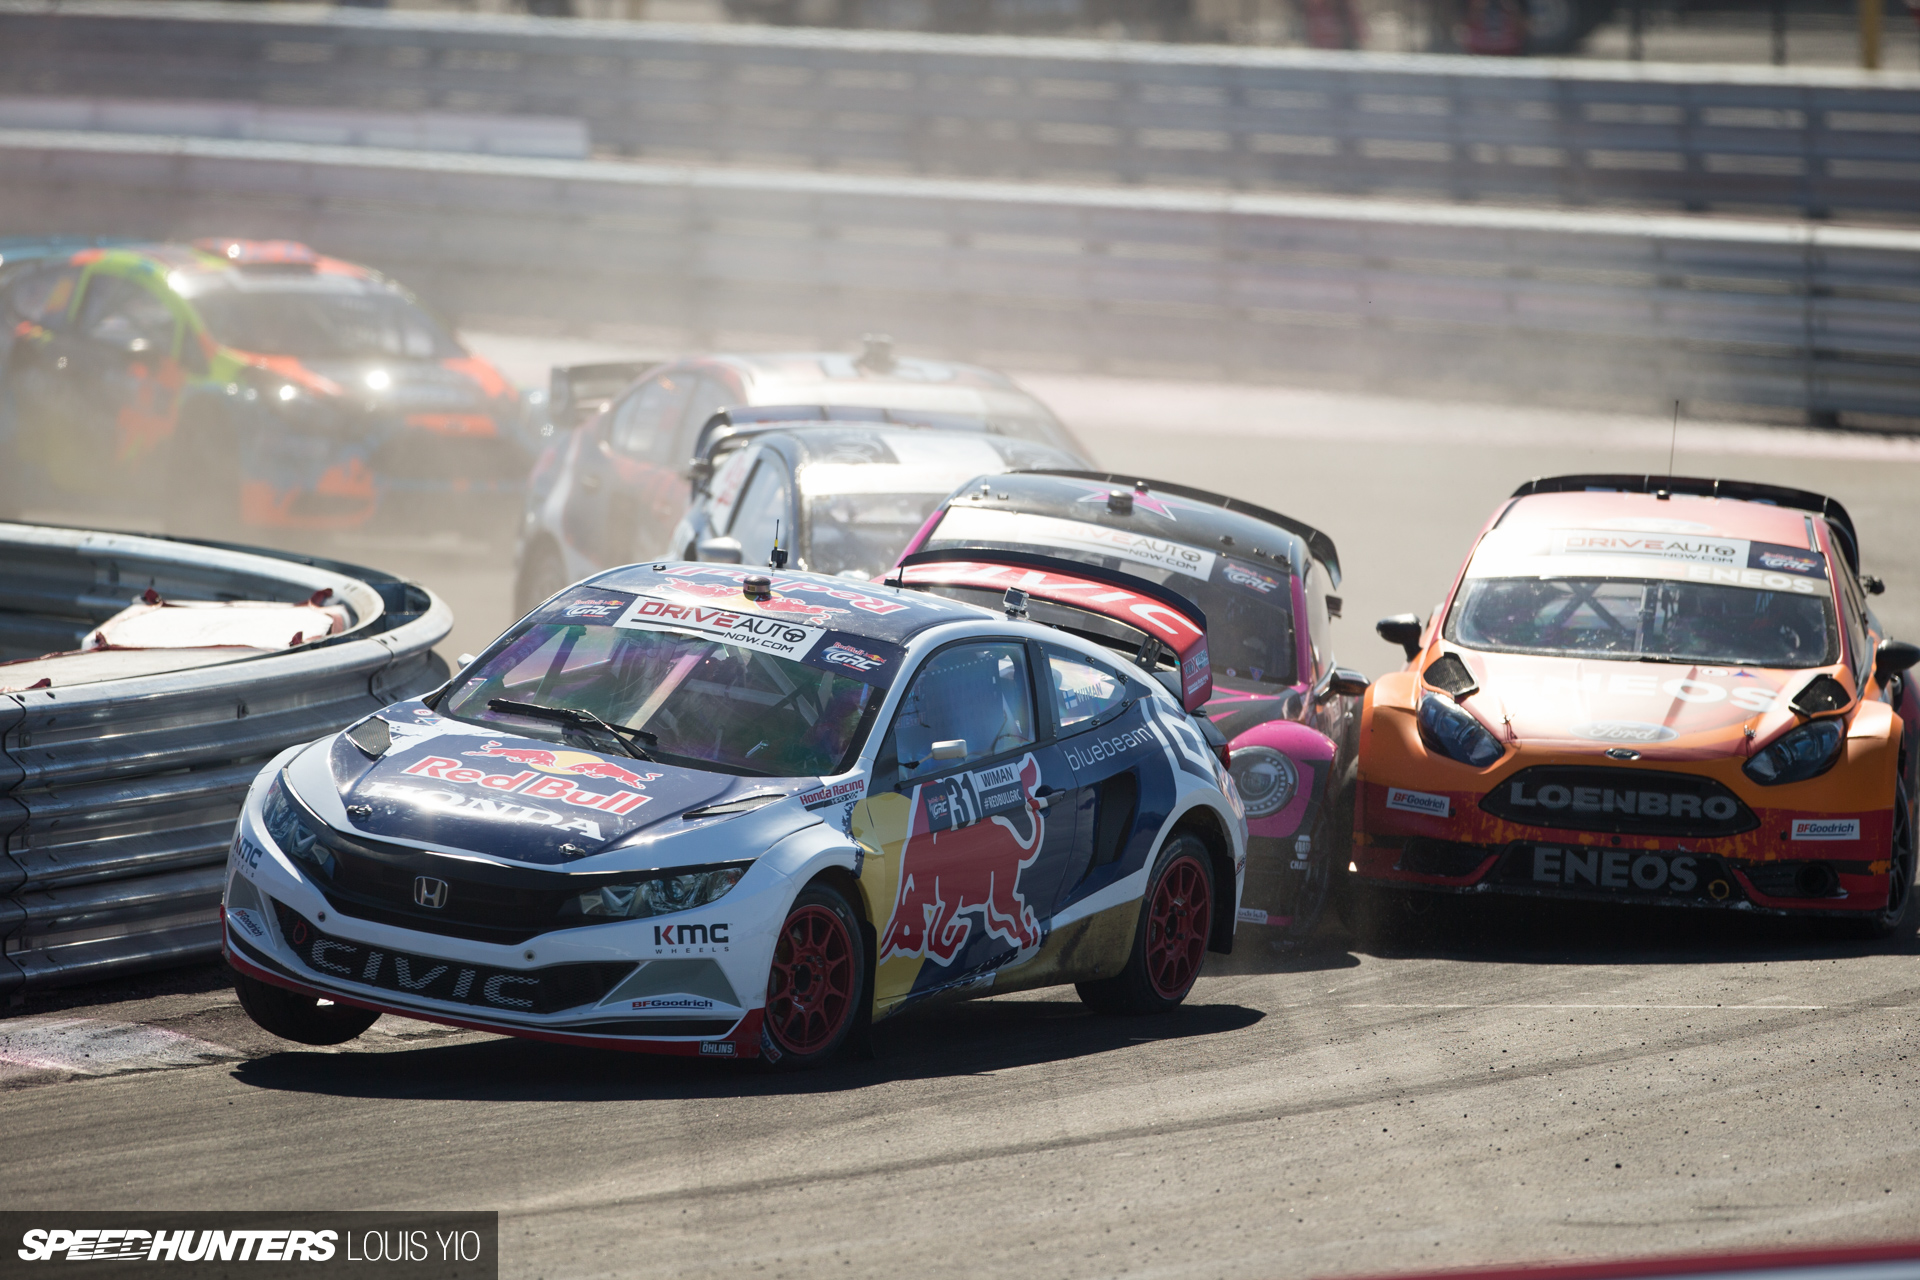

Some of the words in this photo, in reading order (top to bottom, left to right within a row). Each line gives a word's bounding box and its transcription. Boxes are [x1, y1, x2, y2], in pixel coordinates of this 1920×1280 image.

[1127, 547, 1197, 572] NOW.COM
[1688, 565, 1814, 594] ENEOS
[725, 632, 794, 654] NOW.COM
[1064, 727, 1154, 772] bluebeam
[980, 766, 1014, 788] WIMAN
[799, 788, 832, 806] Honda
[832, 779, 865, 797] Racing
[944, 772, 981, 829] 31
[983, 788, 1022, 810] #REDBULLGRC
[1392, 791, 1446, 810] BFGoodrich
[1510, 781, 1738, 821] LOENBRO
[360, 781, 606, 842] HONDA
[1796, 822, 1855, 833] BFGoodrich
[1532, 846, 1698, 892] ENEOS
[655, 946, 730, 955] WHEELS
[311, 939, 540, 1008] CIVIC
[632, 999, 713, 1008] BFGoodrich
[702, 1041, 733, 1054] ÖHLINS
